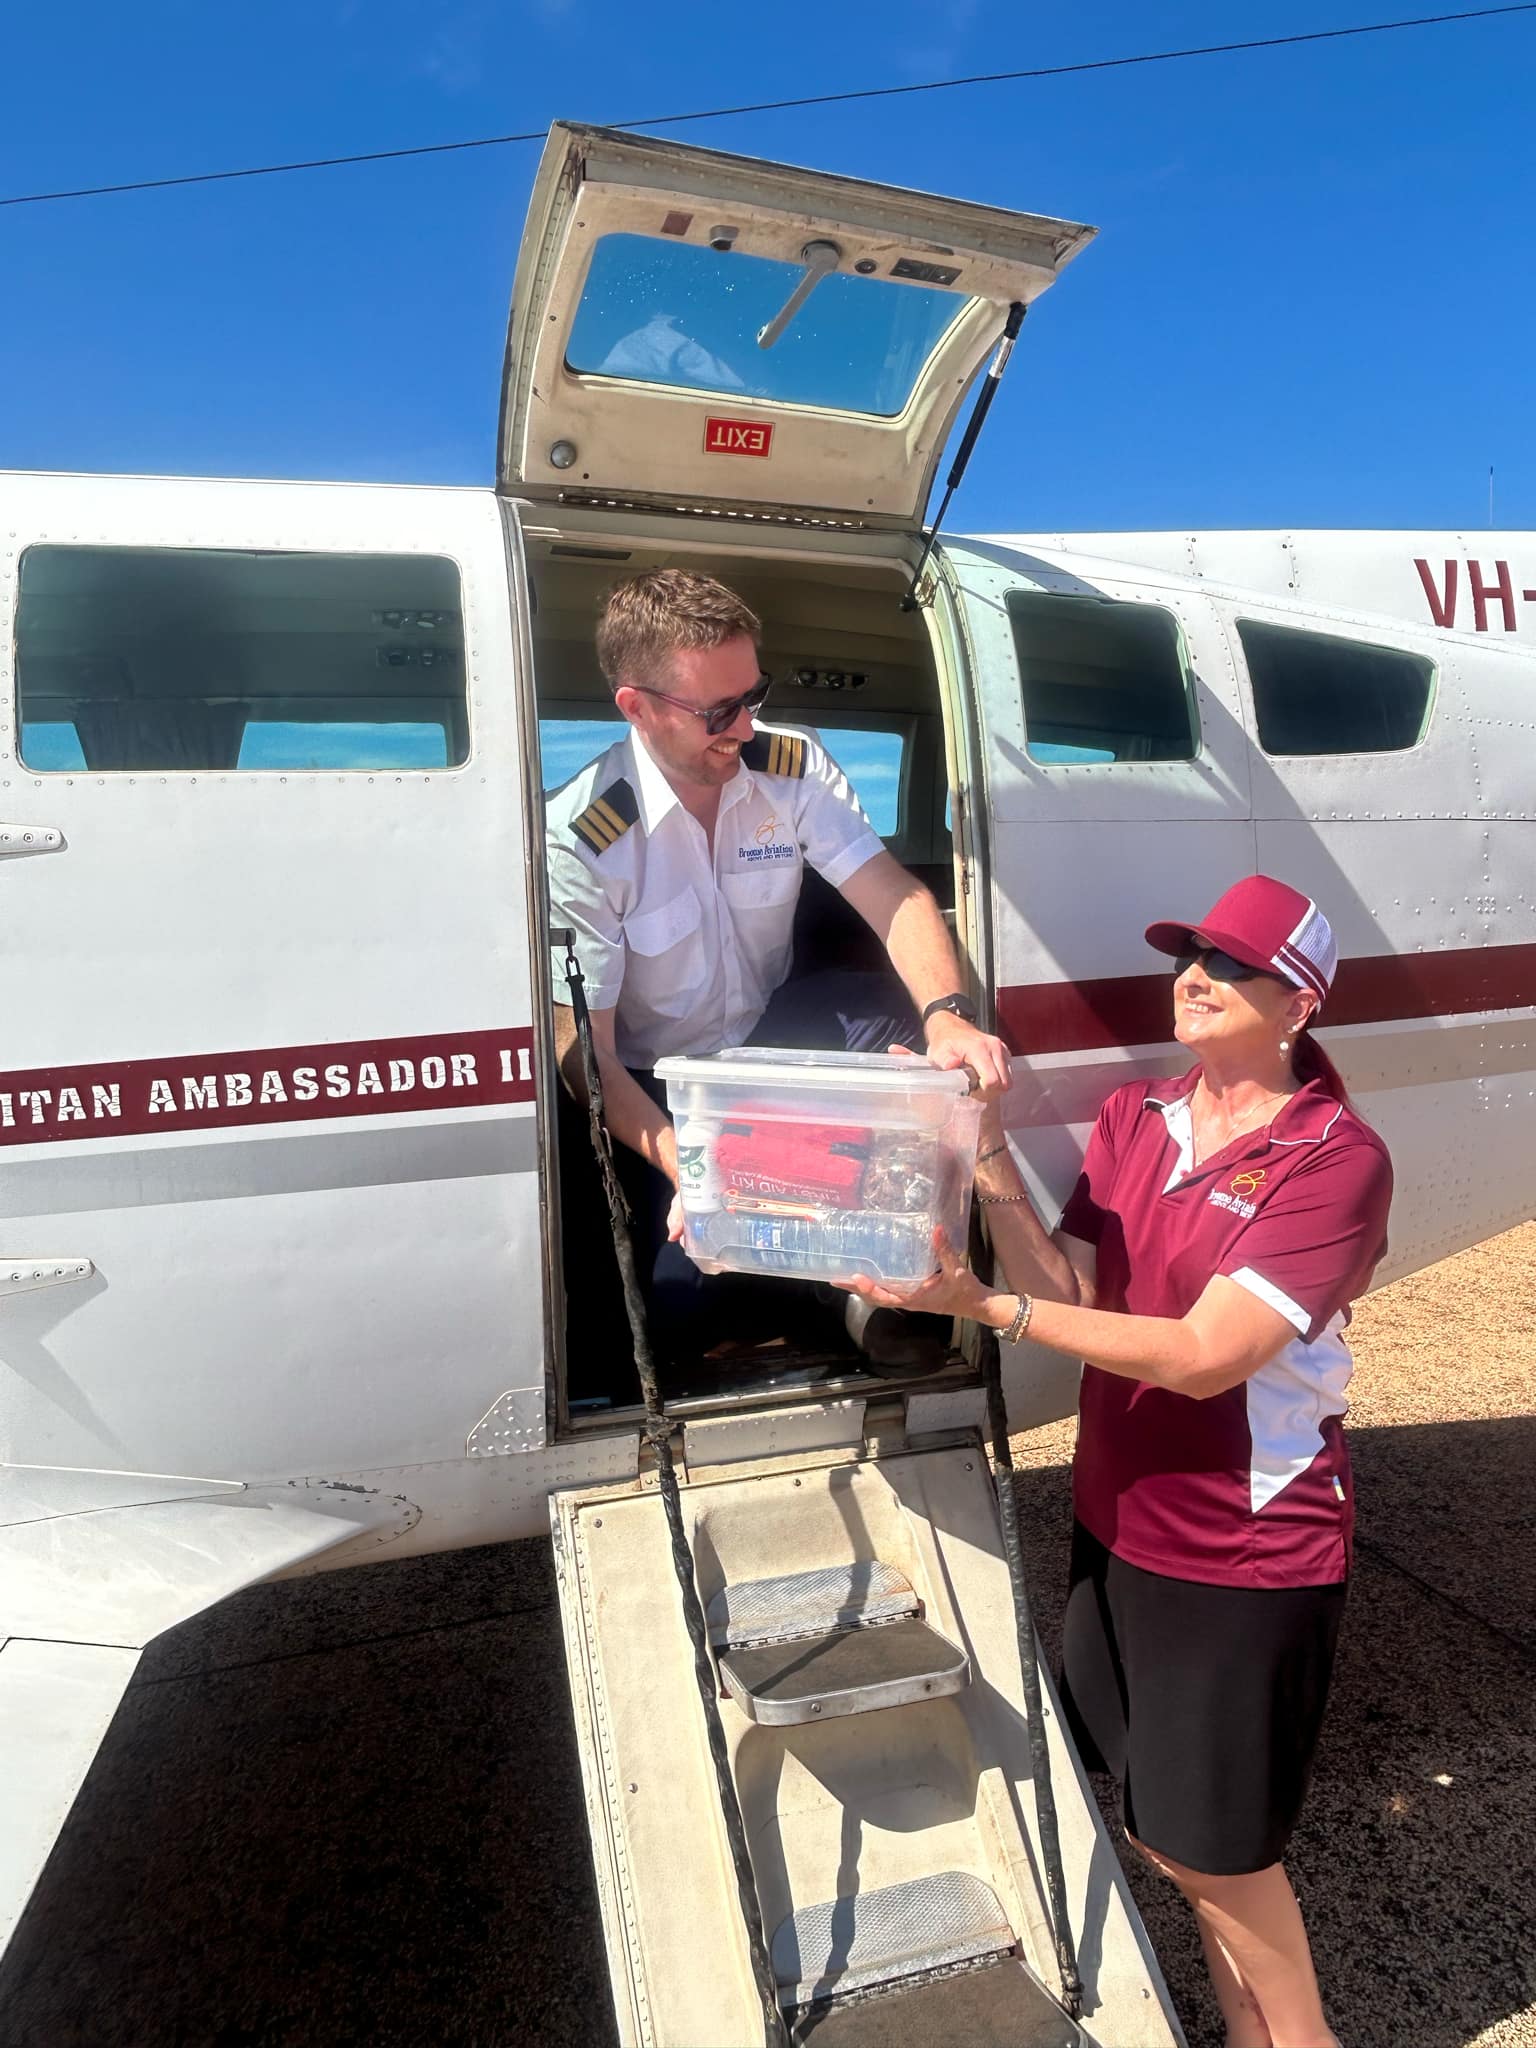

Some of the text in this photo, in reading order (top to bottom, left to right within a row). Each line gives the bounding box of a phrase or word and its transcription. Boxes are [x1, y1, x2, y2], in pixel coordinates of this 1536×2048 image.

[711, 426, 765, 450] EXIT
[148, 1053, 479, 1114] AMBASSADOR
[499, 1047, 532, 1082] II
[730, 1174, 754, 1191] KIT
[759, 1181, 786, 1195] AID
